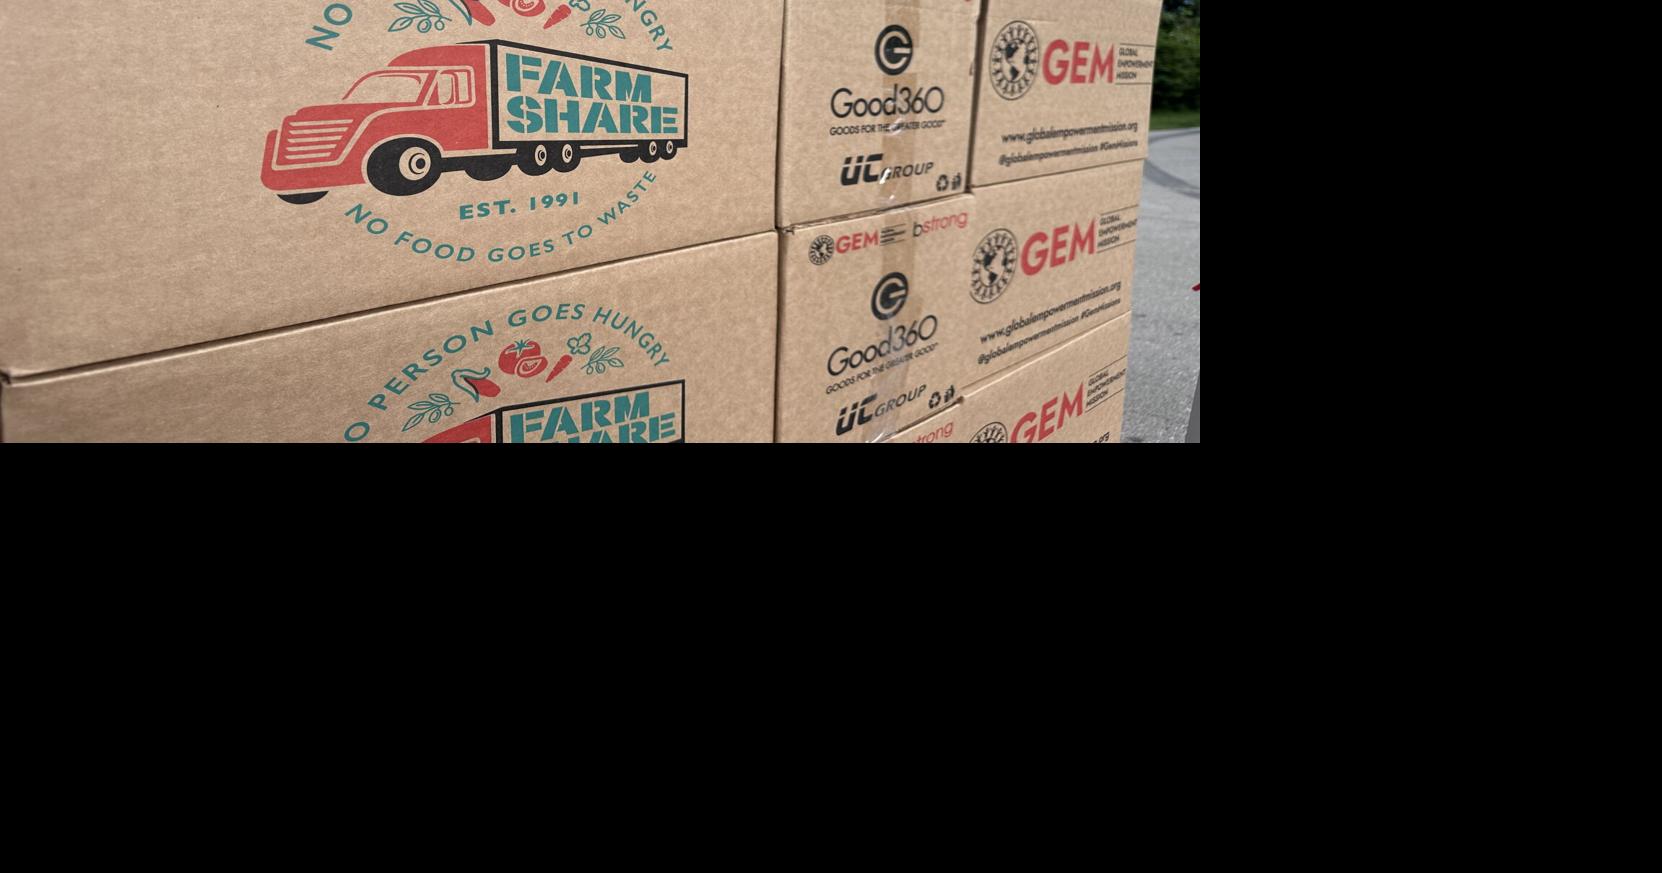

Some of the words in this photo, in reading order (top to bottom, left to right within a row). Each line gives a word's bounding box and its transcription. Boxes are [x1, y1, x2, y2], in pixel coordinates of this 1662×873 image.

[304, 3, 353, 51] NO
[624, 0, 673, 51] NGRY
[505, 53, 652, 103] FARM
[1042, 39, 1115, 85] GEM
[506, 95, 679, 134] SHARE
[830, 84, 945, 118] Good360
[829, 126, 860, 136] GOODS
[861, 125, 876, 134] FOR
[877, 123, 891, 133] THE
[1001, 121, 1138, 144] www.globalempowermentmission.org
[840, 153, 884, 186] UC
[881, 162, 934, 181] GROUP
[344, 203, 388, 235] NO
[394, 231, 475, 262] FOOD
[488, 239, 555, 263] GOES
[562, 224, 593, 245] TO
[597, 170, 657, 225] WASTE
[459, 199, 516, 220] EST.
[529, 191, 579, 211] 1991
[912, 212, 968, 238] bstrong
[836, 230, 879, 254] GEM
[1020, 217, 1097, 276] GEM
[980, 281, 1121, 344] www.globalempowermentmission.org
[367, 319, 494, 411] PERSON
[507, 303, 586, 328] GOES
[592, 306, 670, 368] HUNGRY
[827, 314, 938, 377] Good360
[825, 375, 856, 395] GOODS
[856, 369, 872, 382] FOR
[509, 391, 650, 443] FARM
[836, 393, 878, 436] UC
[874, 384, 927, 417] GROUP
[1010, 381, 1084, 443] GEM
